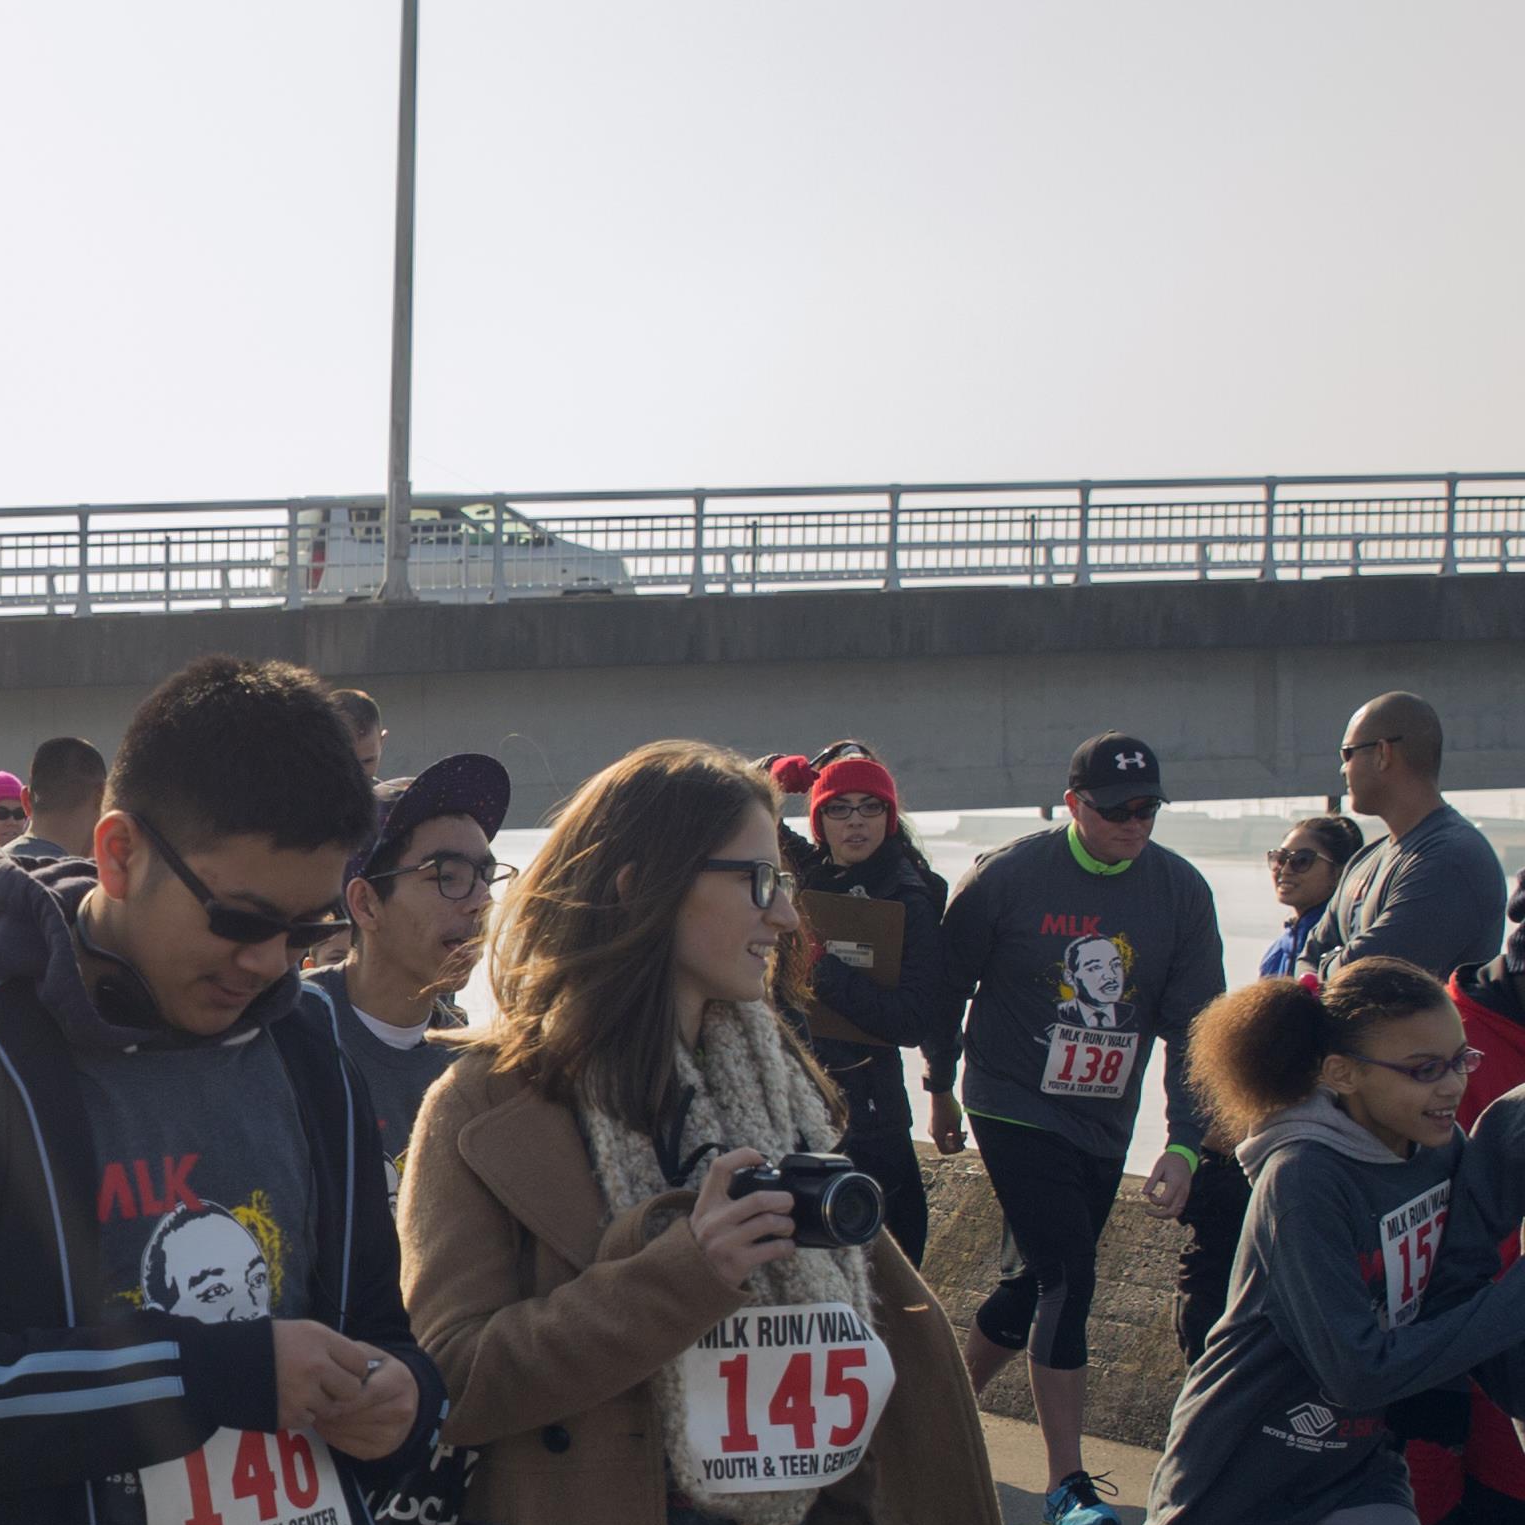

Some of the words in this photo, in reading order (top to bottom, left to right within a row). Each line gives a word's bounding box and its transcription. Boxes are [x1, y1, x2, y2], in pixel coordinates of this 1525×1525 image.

[1039, 911, 1104, 938] MLK
[1059, 1028, 1081, 1042] MLK
[1083, 1030, 1132, 1049] RUN/WALK
[1058, 1043, 1123, 1085] 138
[1048, 1080, 1069, 1092] YOUTH
[1077, 1082, 1092, 1093] TEEN
[1094, 1084, 1119, 1095] CENTER
[1387, 1210, 1407, 1242] MLK
[719, 1347, 870, 1453] 145
[1262, 1425, 1287, 1440] BOYS
[1296, 1436, 1324, 1448] GIRLS
[702, 1456, 757, 1480] YOUTH
[763, 1456, 776, 1477] &
[779, 1454, 819, 1477] TEEN
[823, 1445, 863, 1474] CENTER
